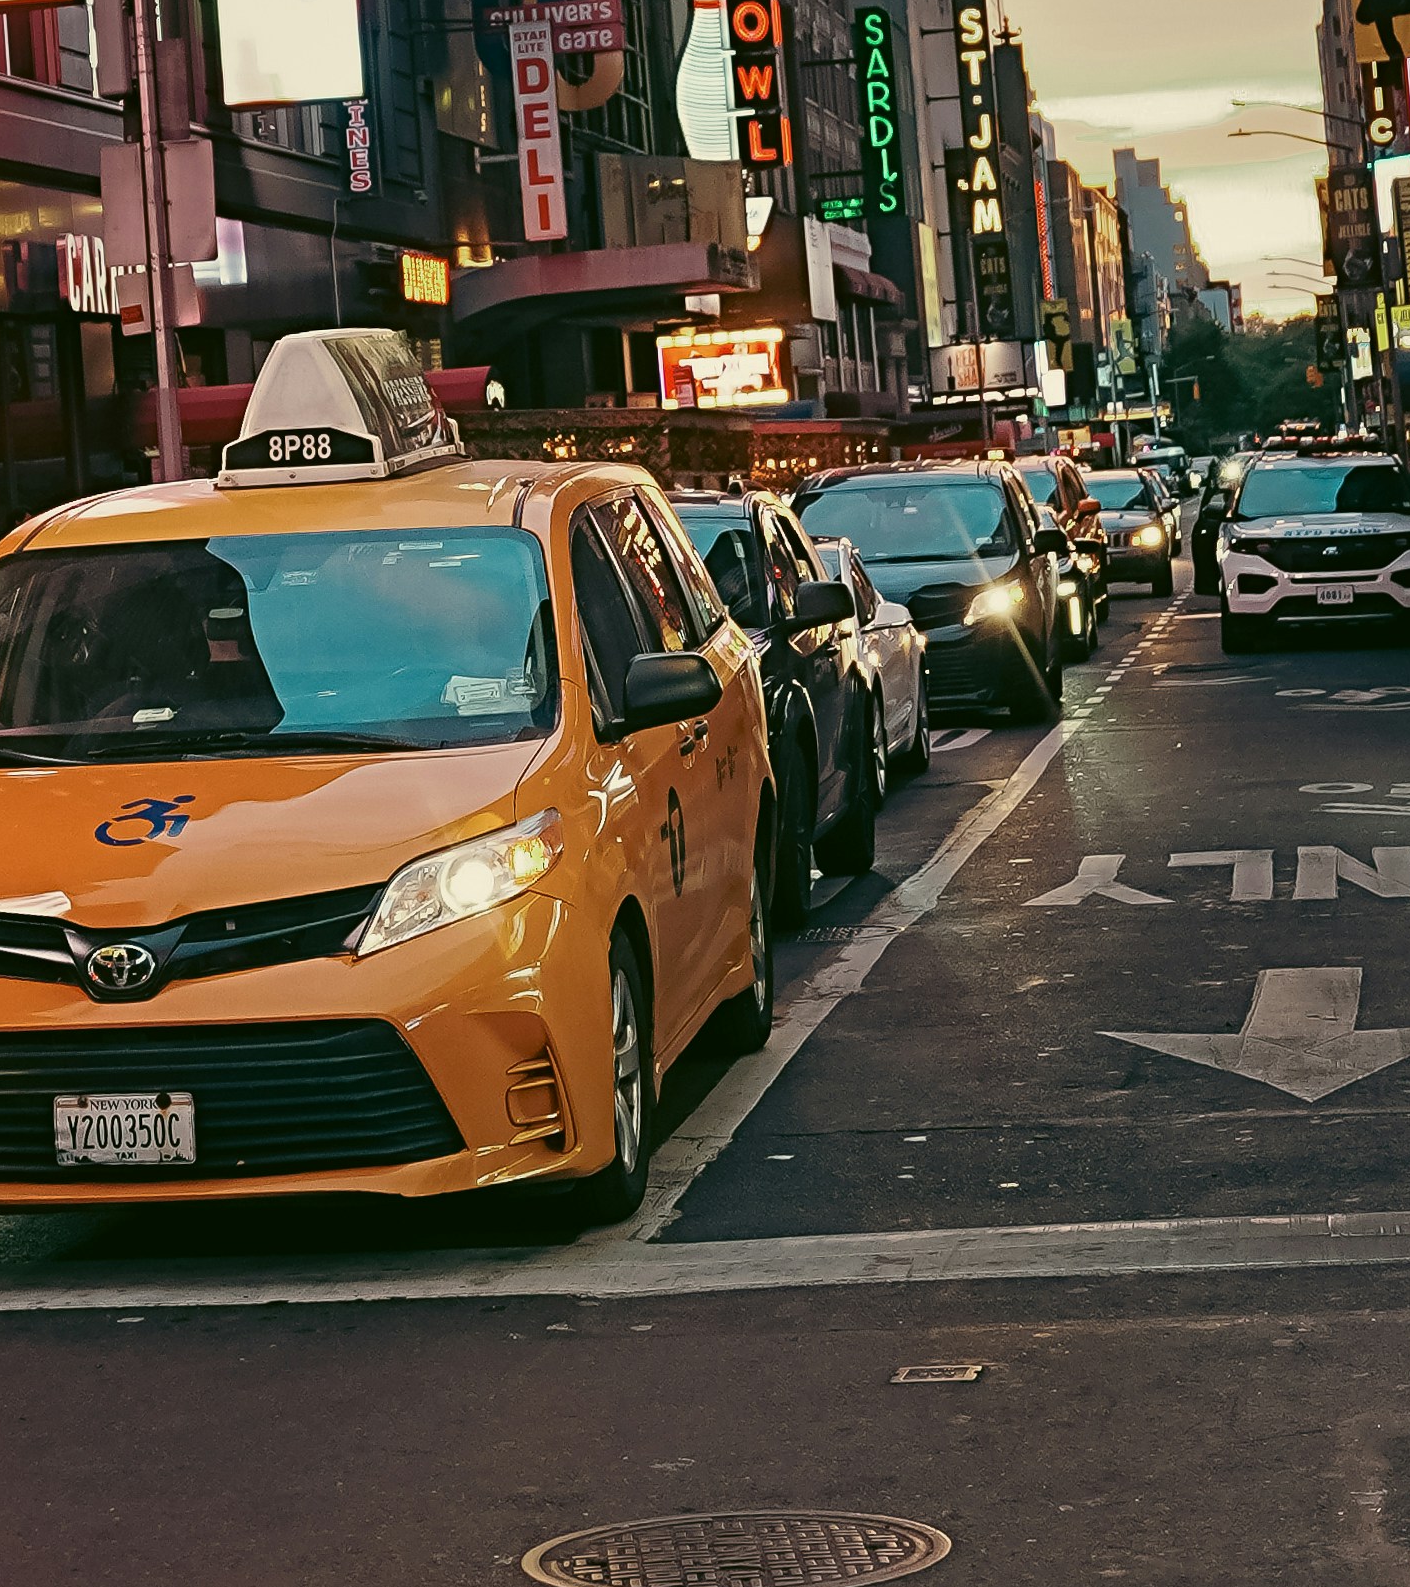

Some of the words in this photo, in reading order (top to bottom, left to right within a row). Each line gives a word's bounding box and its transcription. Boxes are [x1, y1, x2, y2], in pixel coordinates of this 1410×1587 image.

[513, 30, 547, 42] STAR
[517, 42, 545, 54] LITE
[343, 99, 372, 192] INES
[516, 58, 555, 231] DELI
[269, 434, 331, 461] 8P88
[90, 1099, 122, 1111] NEW
[124, 1098, 158, 1111] YORK
[67, 1113, 181, 1150] Y200350C
